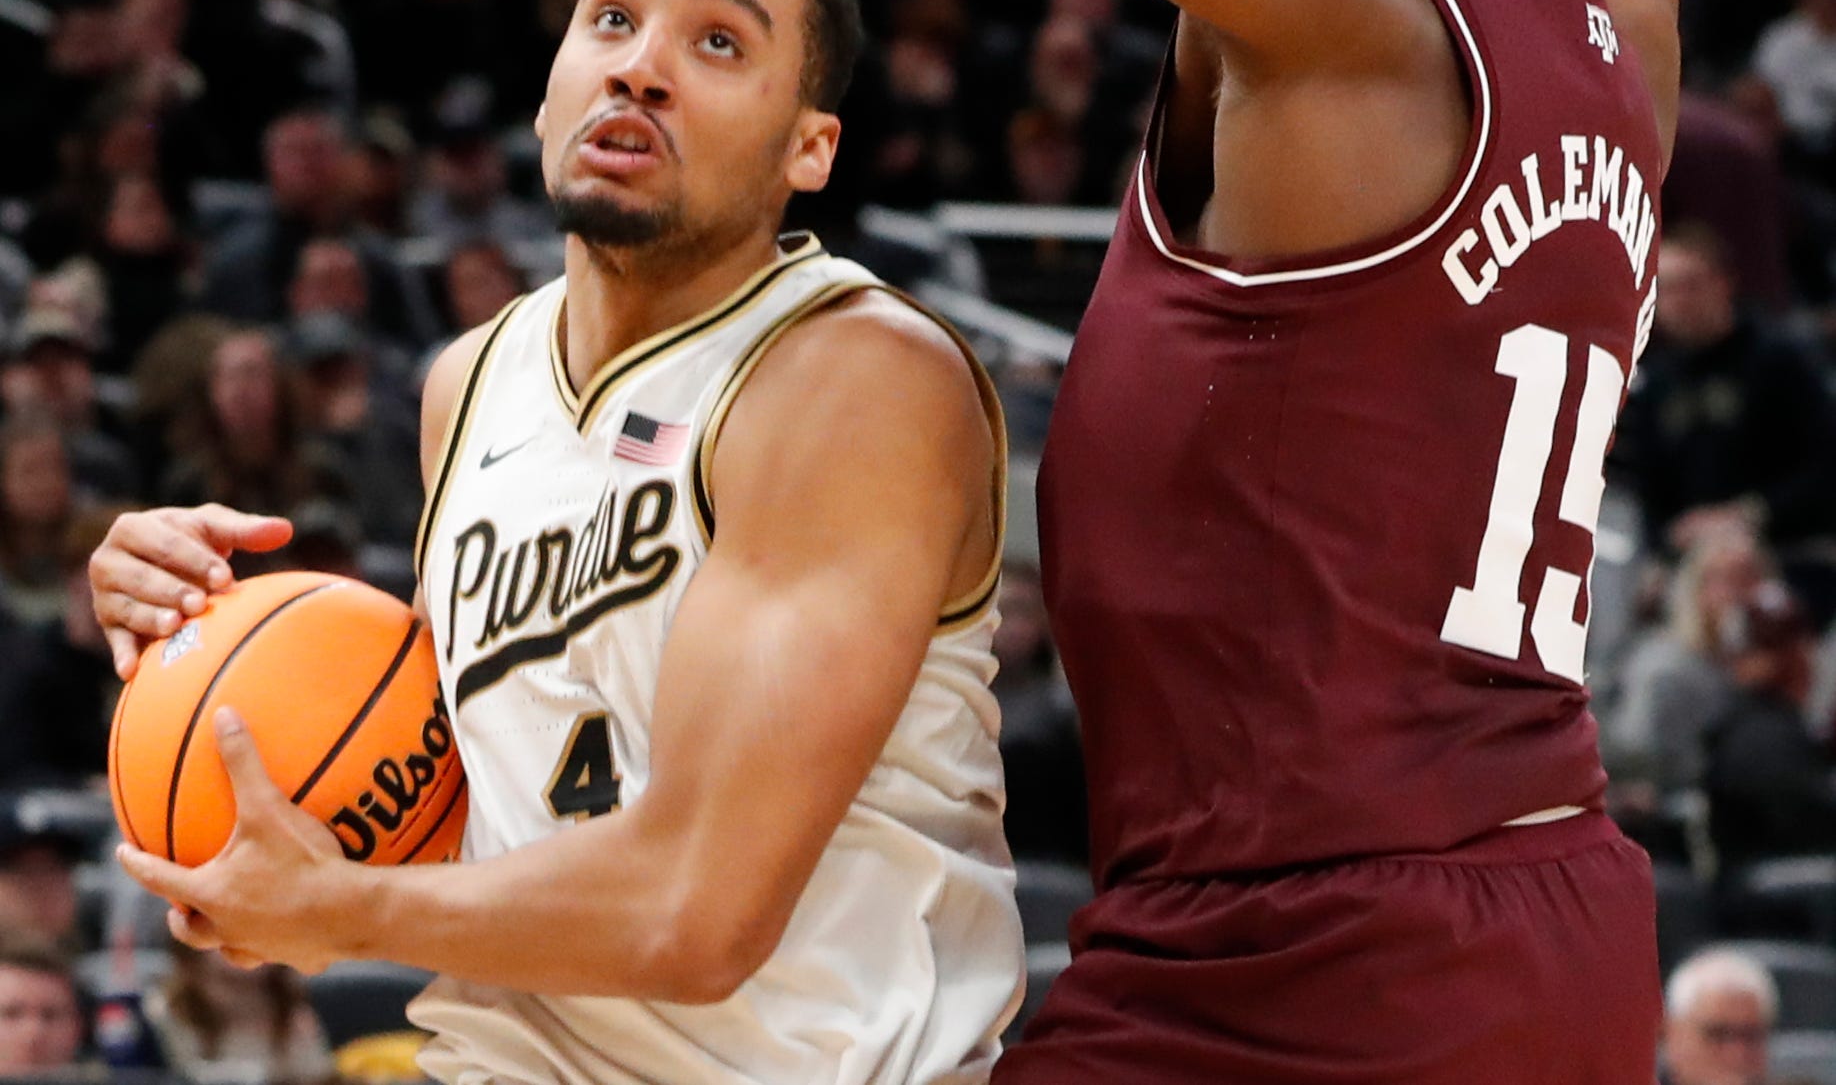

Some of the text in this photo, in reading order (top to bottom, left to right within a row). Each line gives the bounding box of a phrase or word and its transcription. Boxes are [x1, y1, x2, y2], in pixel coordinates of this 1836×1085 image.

[1441, 134, 1656, 306] COLEMAN
[445, 478, 682, 665] Purdue
[1439, 322, 1625, 684] 15
[541, 709, 623, 824] 4
